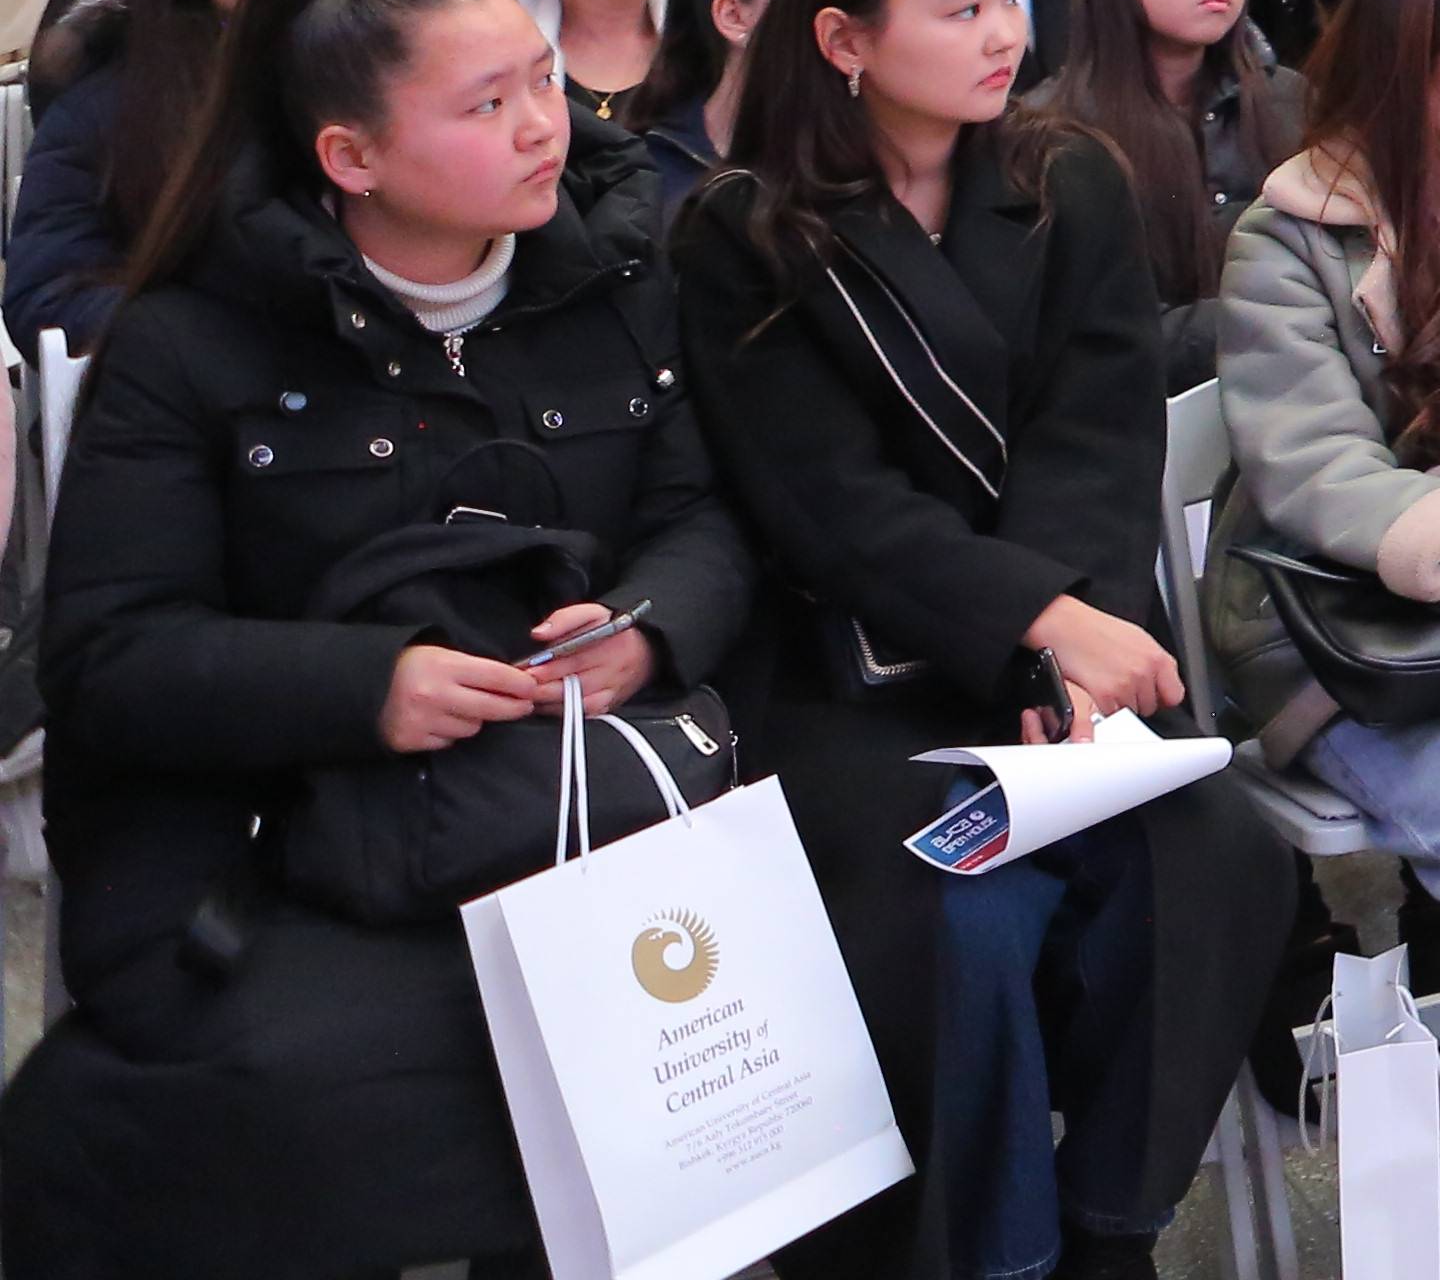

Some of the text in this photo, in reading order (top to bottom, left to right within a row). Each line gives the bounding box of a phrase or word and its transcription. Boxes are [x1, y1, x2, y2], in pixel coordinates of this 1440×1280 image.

[653, 1019, 769, 1085] University of
[658, 998, 744, 1051] American
[666, 1048, 780, 1114] Central Asia
